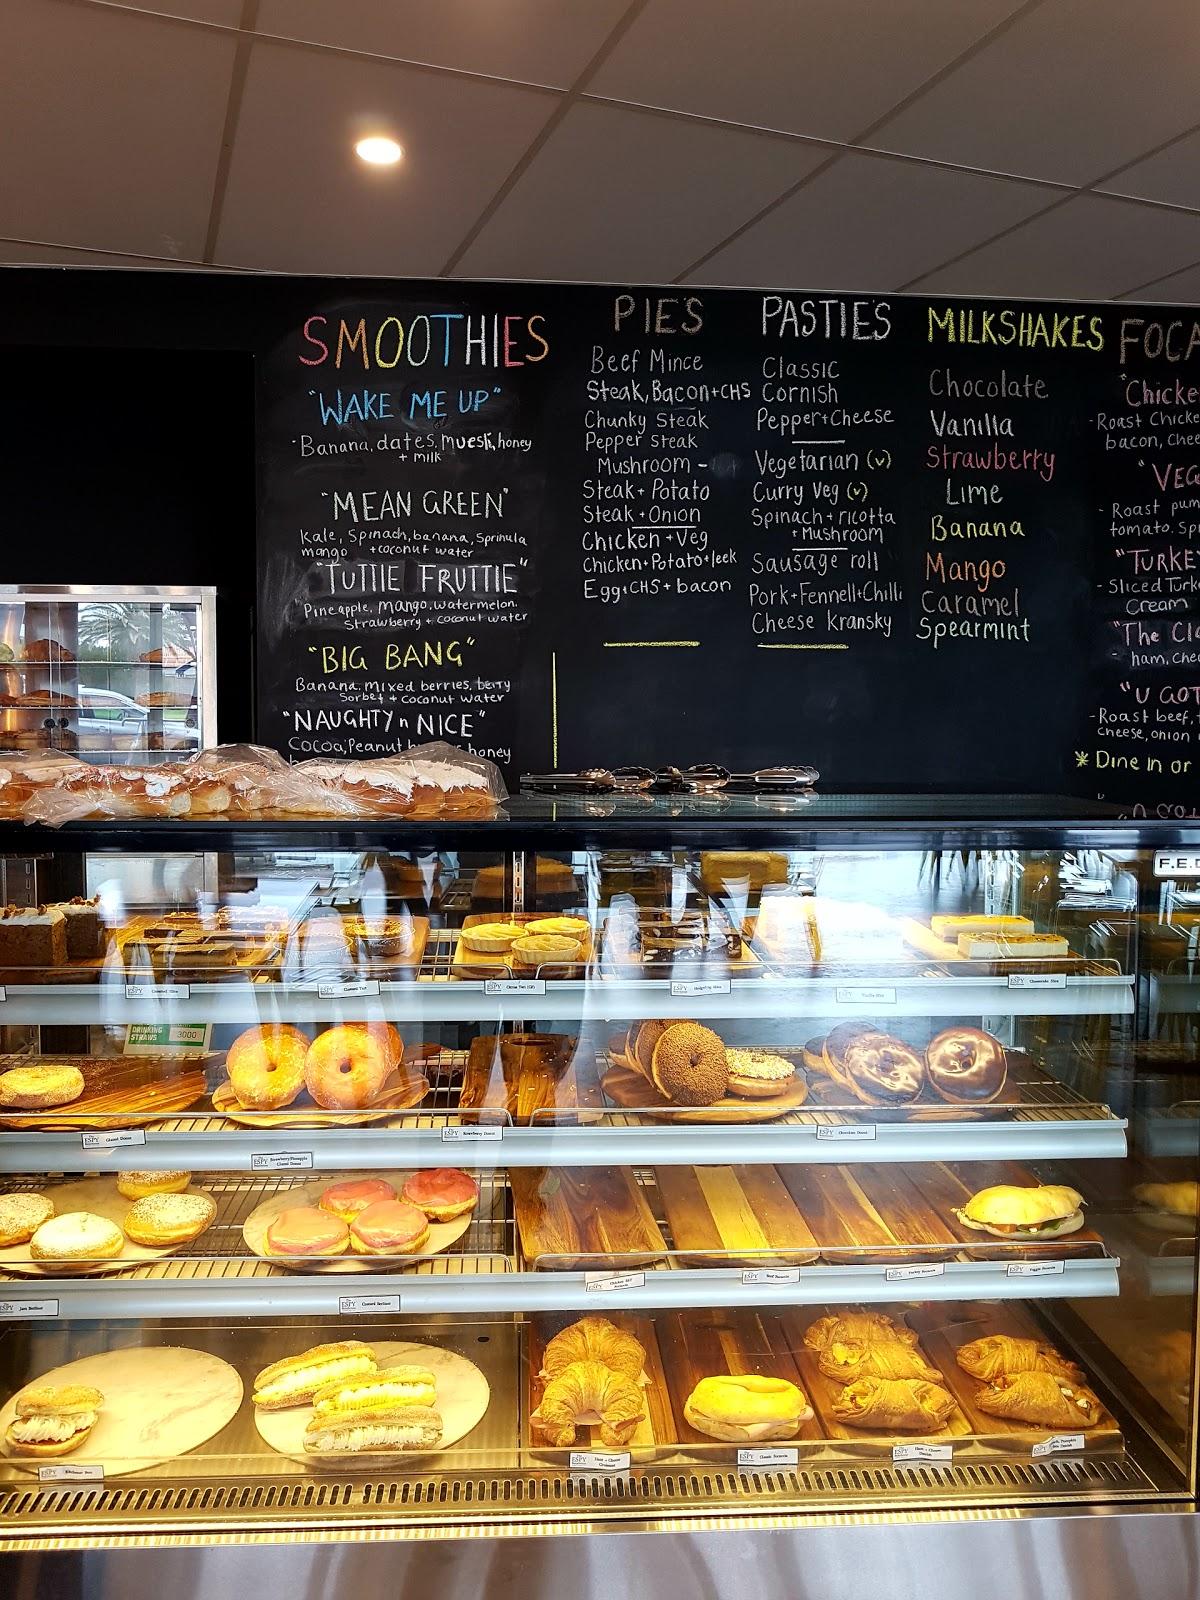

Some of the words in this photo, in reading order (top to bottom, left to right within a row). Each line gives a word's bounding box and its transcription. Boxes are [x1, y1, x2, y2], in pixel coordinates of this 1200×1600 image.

[927, 306, 1105, 351] MILKSHAKES
[299, 313, 549, 370] SMOOTHIES
[591, 345, 640, 374] Beef
[650, 348, 704, 374] Mince
[763, 356, 840, 379] Classic
[762, 382, 838, 403] Cornish
[929, 368, 1049, 399] Chocolate
[409, 390, 447, 419] ME
[584, 410, 646, 435] Chunky
[930, 409, 1014, 437] Vanilla
[498, 431, 532, 451] honey
[585, 431, 643, 454] Pepper
[414, 452, 441, 464] milk
[598, 456, 691, 475] Mushroom
[755, 449, 859, 479] Vegetarian
[926, 441, 1055, 482] Strawberry
[652, 478, 710, 501] Potato
[753, 481, 803, 506] Curry
[813, 481, 839, 505] Veg
[946, 478, 1004, 505] Lime
[649, 505, 701, 523] Onion
[751, 508, 822, 529] Spinach
[838, 507, 896, 525] ricotta
[802, 526, 884, 544] Mushroom
[931, 514, 1025, 541] Banana
[582, 528, 660, 551] Chicken
[676, 529, 708, 551] Veg
[301, 547, 348, 563] mango
[435, 547, 474, 559] water
[751, 552, 838, 577] Sausage
[851, 550, 879, 571] roll
[1116, 546, 1200, 575] "TURKE
[926, 552, 1006, 593] Mango
[676, 578, 731, 593] bacon
[1108, 577, 1162, 594] Sliced
[921, 588, 1020, 617] Caramel
[1126, 598, 1188, 615] Cream
[437, 614, 485, 624] coconut
[487, 612, 529, 623] water
[752, 612, 815, 634] Cheese
[916, 616, 1030, 649] Spearmint
[365, 681, 414, 692] mixed
[401, 693, 455, 704] coconut
[461, 692, 505, 703] water
[1151, 730, 1190, 743] onion
[468, 743, 512, 764] honey
[1096, 751, 1140, 770] Dine
[1170, 761, 1192, 774] or
[130, 1033, 157, 1041] STRAWS
[132, 1026, 163, 1034] DRINKING
